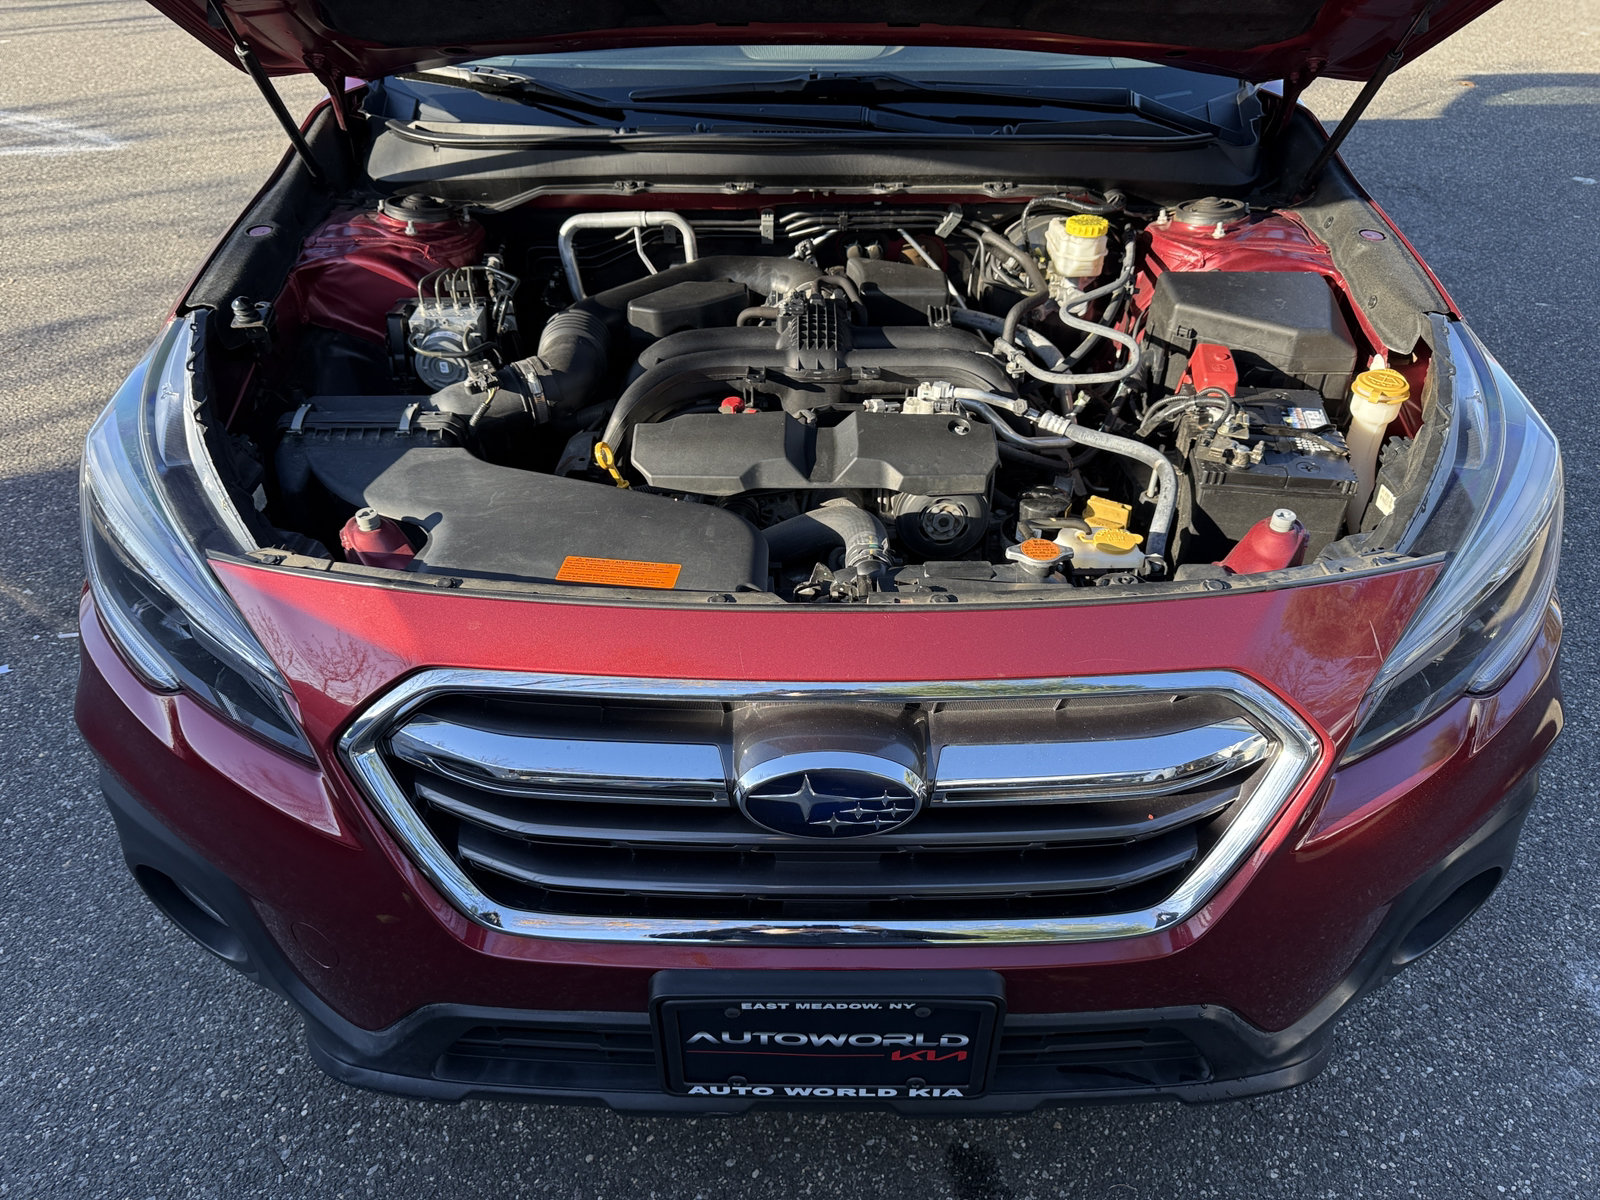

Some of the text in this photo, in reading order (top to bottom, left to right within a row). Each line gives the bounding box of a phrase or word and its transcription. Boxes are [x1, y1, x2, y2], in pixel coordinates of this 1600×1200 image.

[741, 1002, 790, 1010] EAST
[686, 1031, 970, 1047] AUTOWORLD
[687, 1085, 964, 1097] AUTO WORLD KIA
